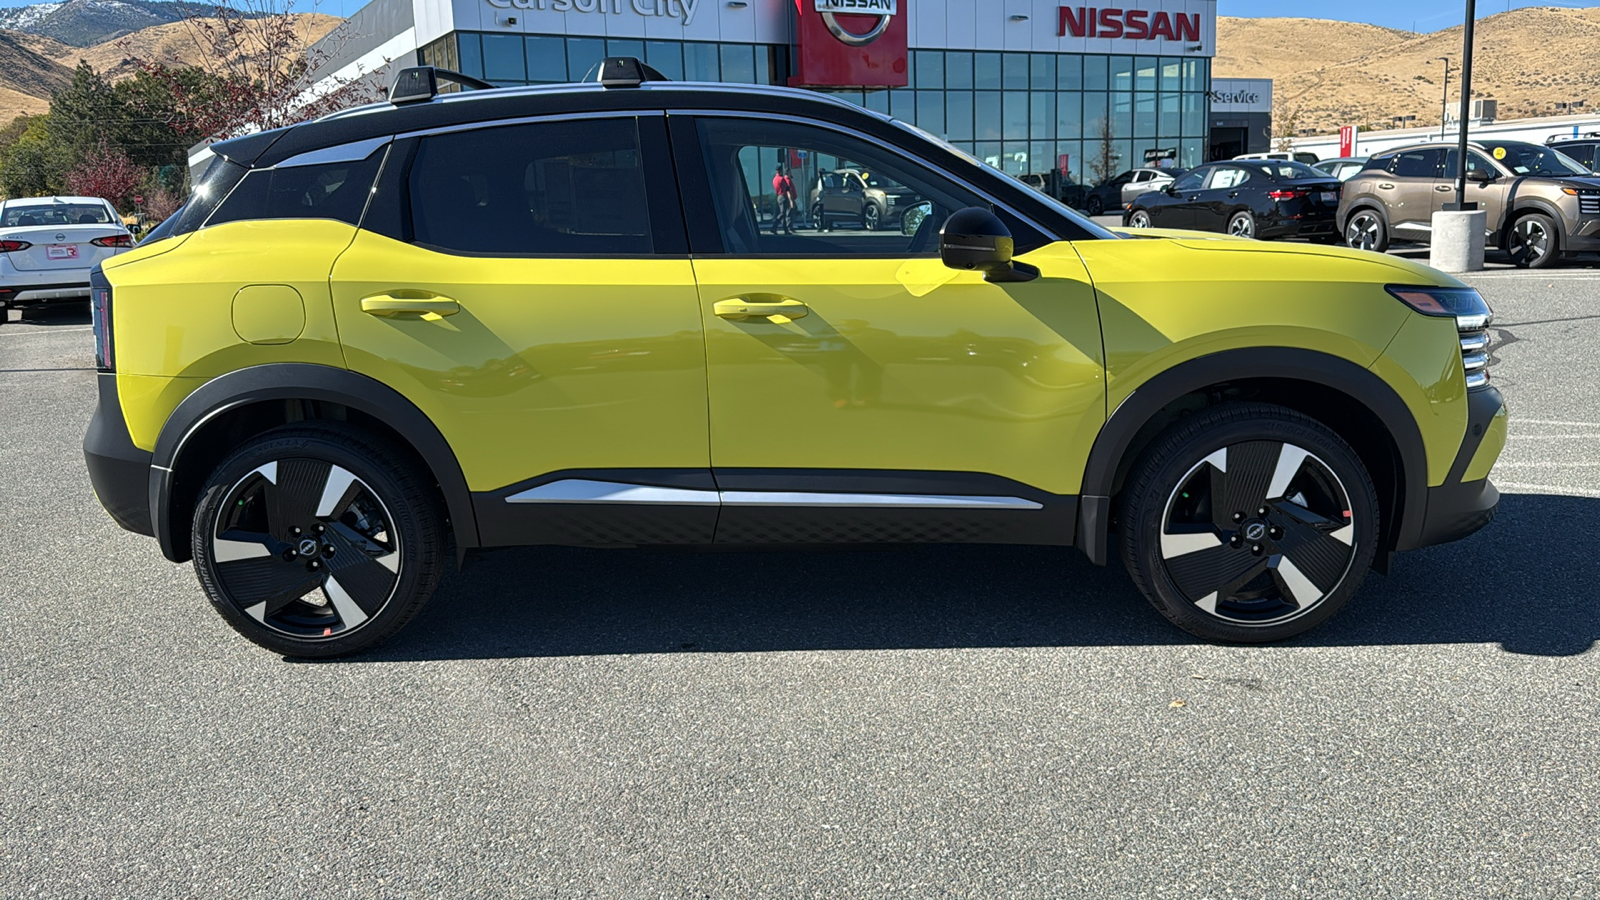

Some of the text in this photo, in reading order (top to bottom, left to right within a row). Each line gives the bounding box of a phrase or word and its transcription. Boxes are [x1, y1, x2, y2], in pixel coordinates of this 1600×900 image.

[631, 0, 700, 26] City
[1058, 6, 1200, 41] NISSAN
[1215, 90, 1259, 103] Service
[392, 497, 417, 562] BRIDGESTONE
[196, 533, 222, 603] BRIDGESTONE
